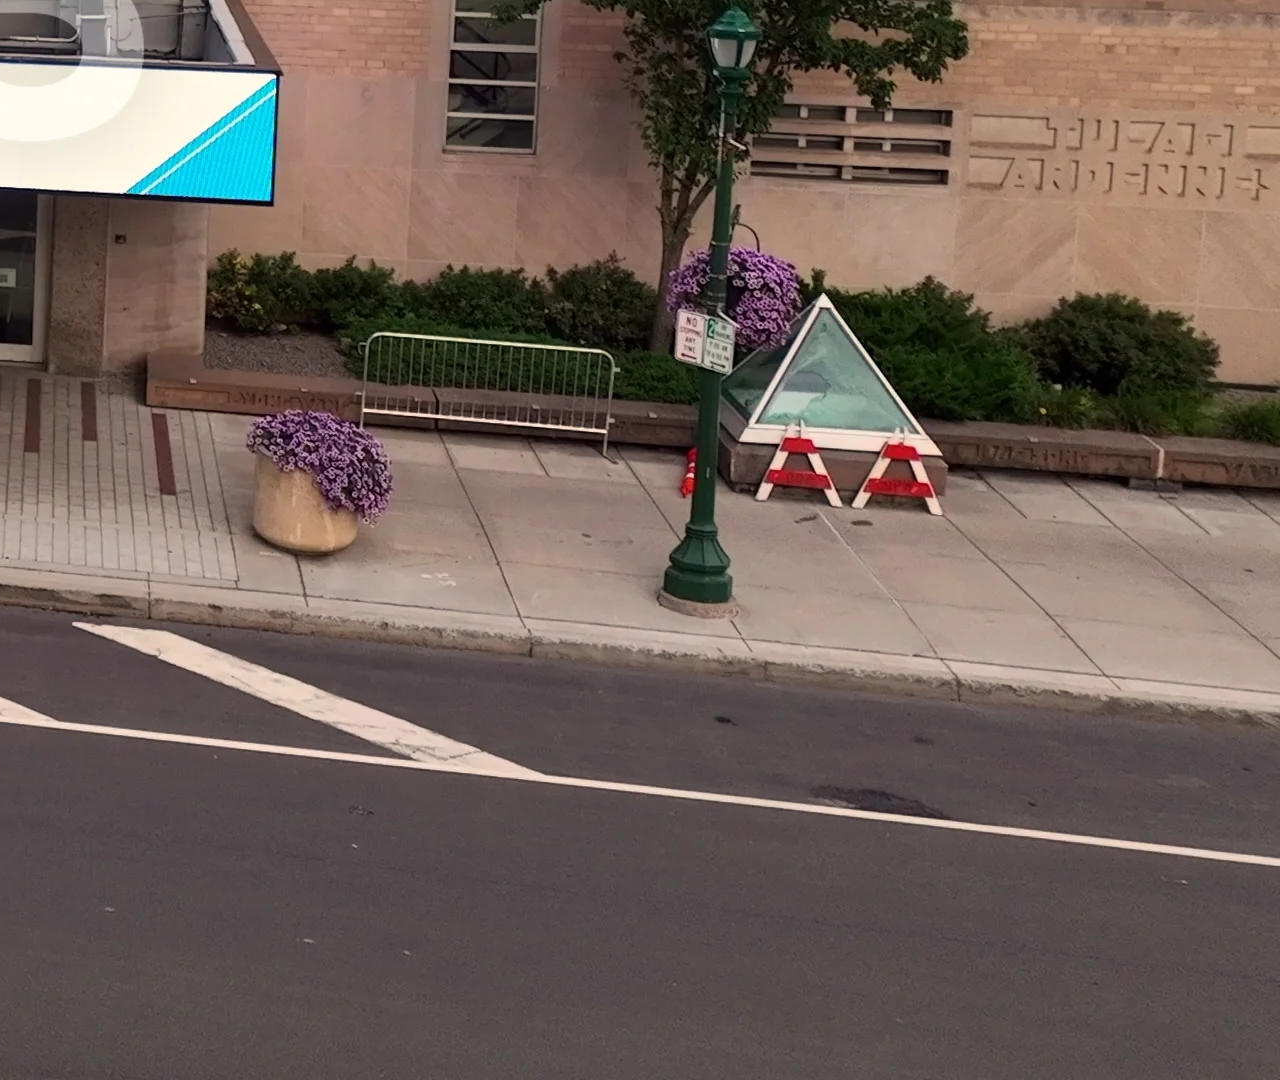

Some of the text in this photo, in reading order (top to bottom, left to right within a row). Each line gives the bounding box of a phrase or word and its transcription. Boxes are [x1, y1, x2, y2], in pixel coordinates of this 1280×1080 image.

[685, 316, 698, 328] NO
[708, 319, 716, 337] 2
[680, 326, 702, 338] STOPPING
[685, 336, 696, 344] ANY
[683, 344, 696, 353] TIME
